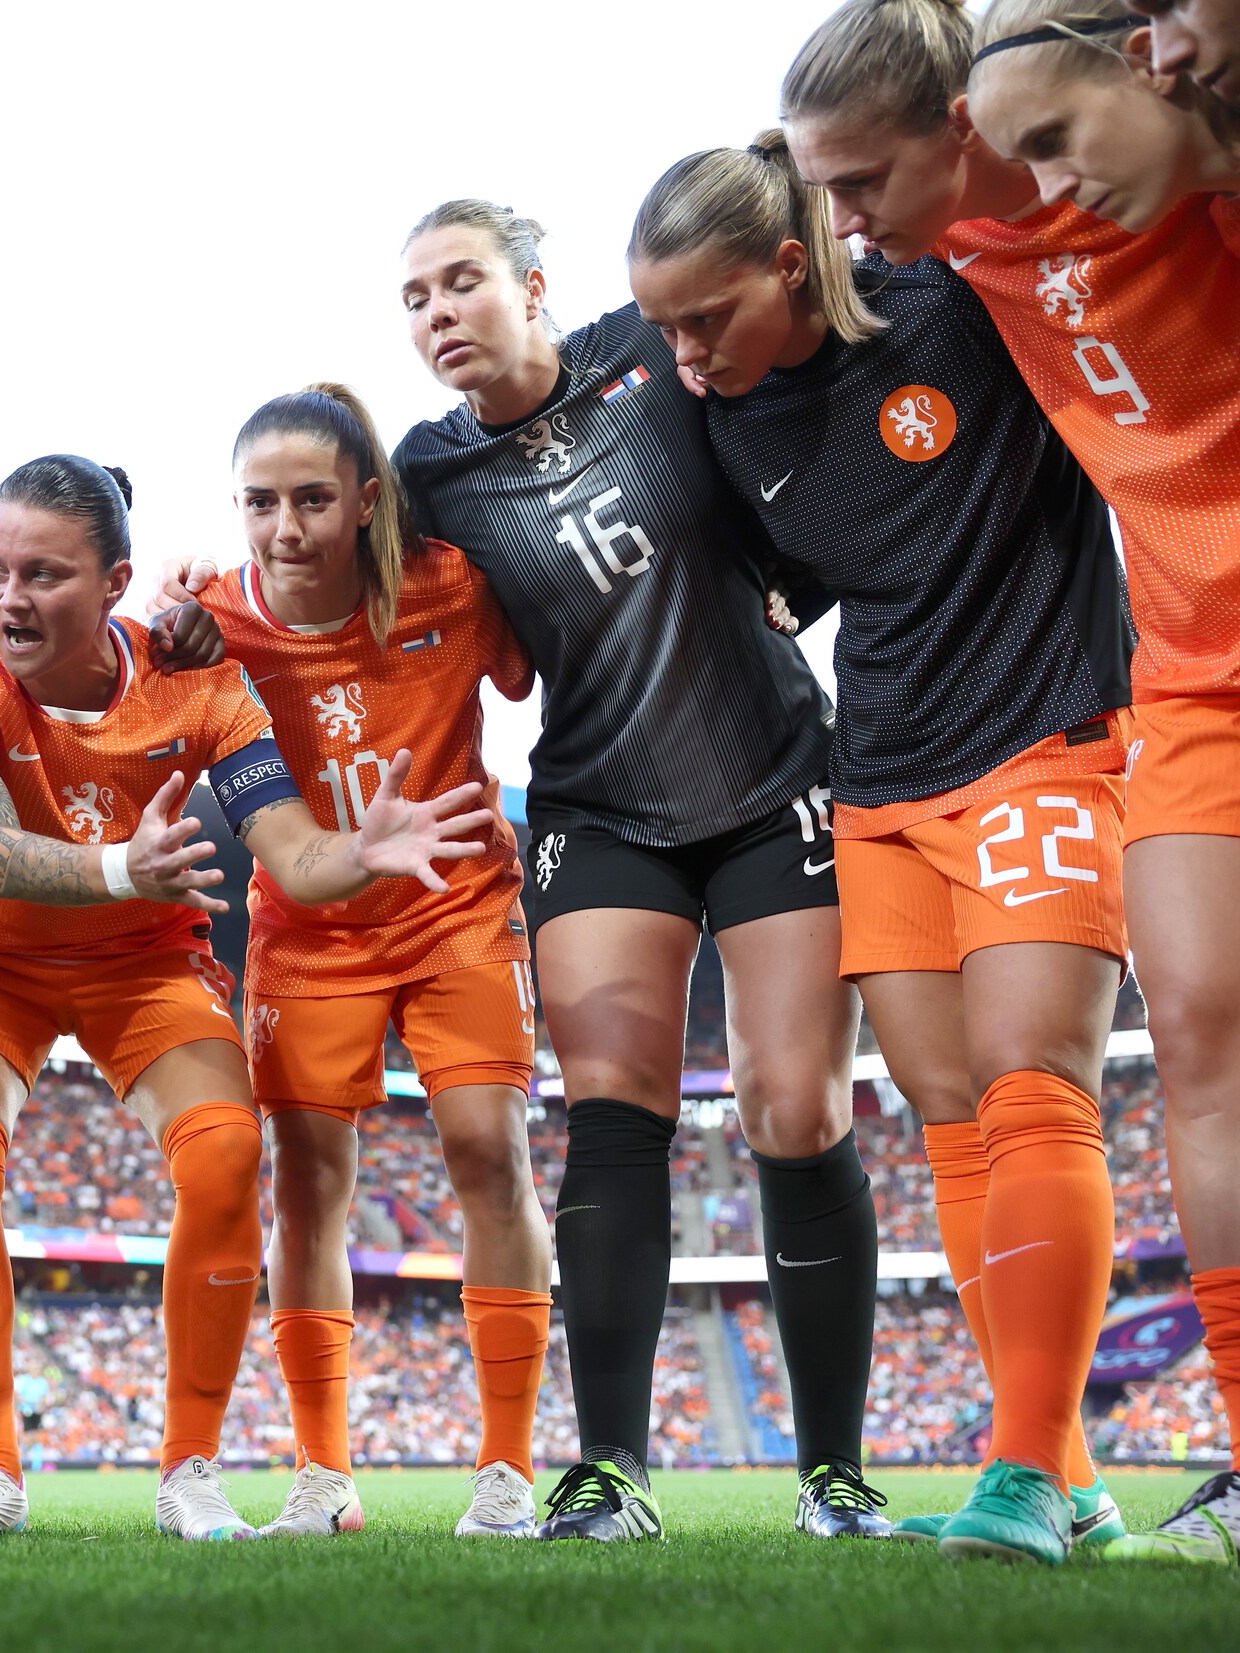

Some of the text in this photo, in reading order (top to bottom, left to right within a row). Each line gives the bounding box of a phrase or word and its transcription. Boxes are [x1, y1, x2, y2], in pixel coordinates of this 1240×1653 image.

[1072, 336, 1150, 425] 9
[556, 486, 655, 594] 16
[232, 762, 286, 790] RESPECT
[317, 750, 392, 832] 10
[977, 796, 1099, 887] 22
